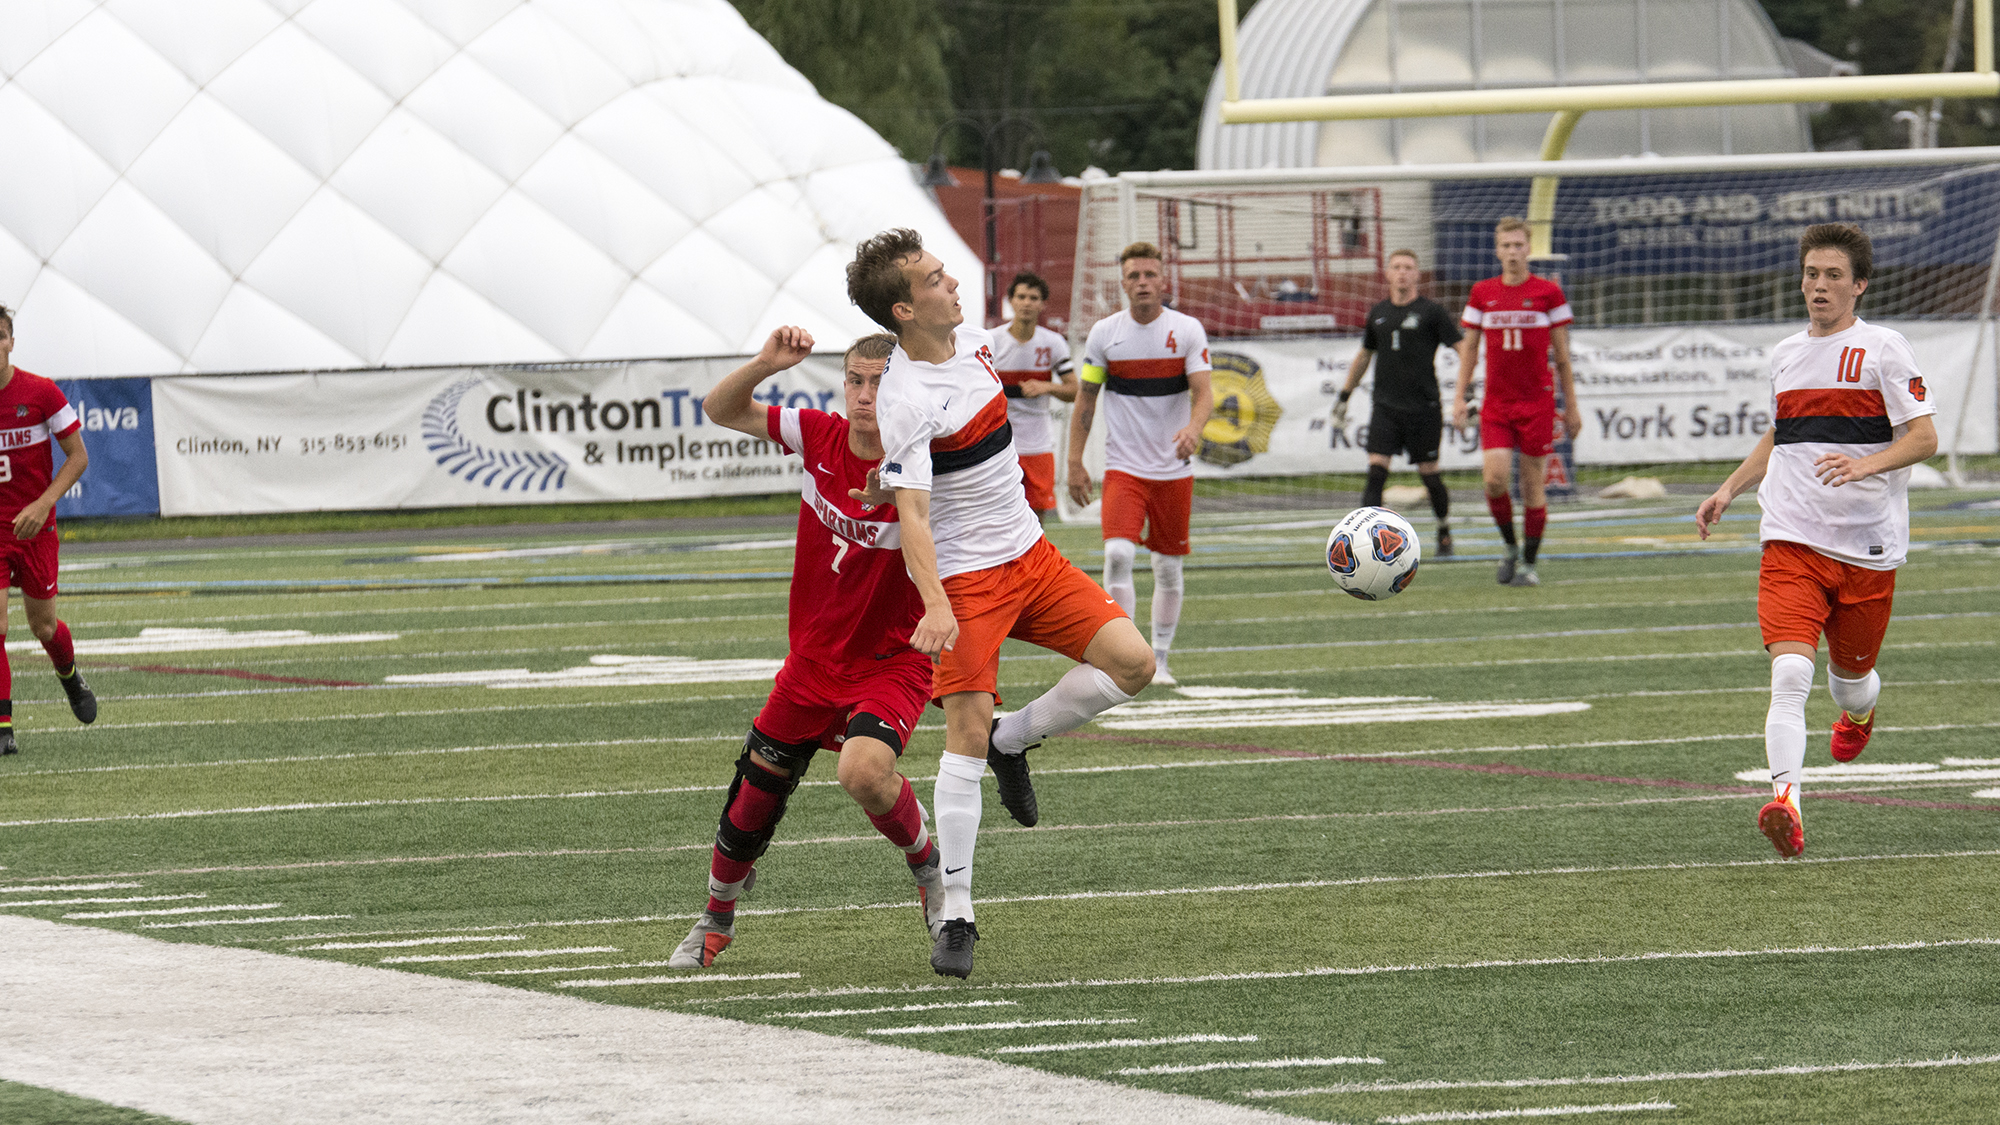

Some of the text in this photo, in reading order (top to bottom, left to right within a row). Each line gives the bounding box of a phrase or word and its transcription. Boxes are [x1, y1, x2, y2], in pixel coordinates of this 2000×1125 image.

[1165, 329, 1178, 354] 4
[1391, 329, 1400, 351] 1
[1502, 328, 1524, 351] 11
[1034, 346, 1052, 368] 23
[1836, 346, 1866, 383] 10
[74, 400, 139, 432] lava
[1596, 402, 1770, 440] York Safe
[176, 432, 408, 456] Clinton, NY 315-853-6151
[584, 443, 604, 465] &
[670, 467, 697, 482] The
[813, 490, 879, 546] SPARTANS
[831, 533, 850, 575] 7
